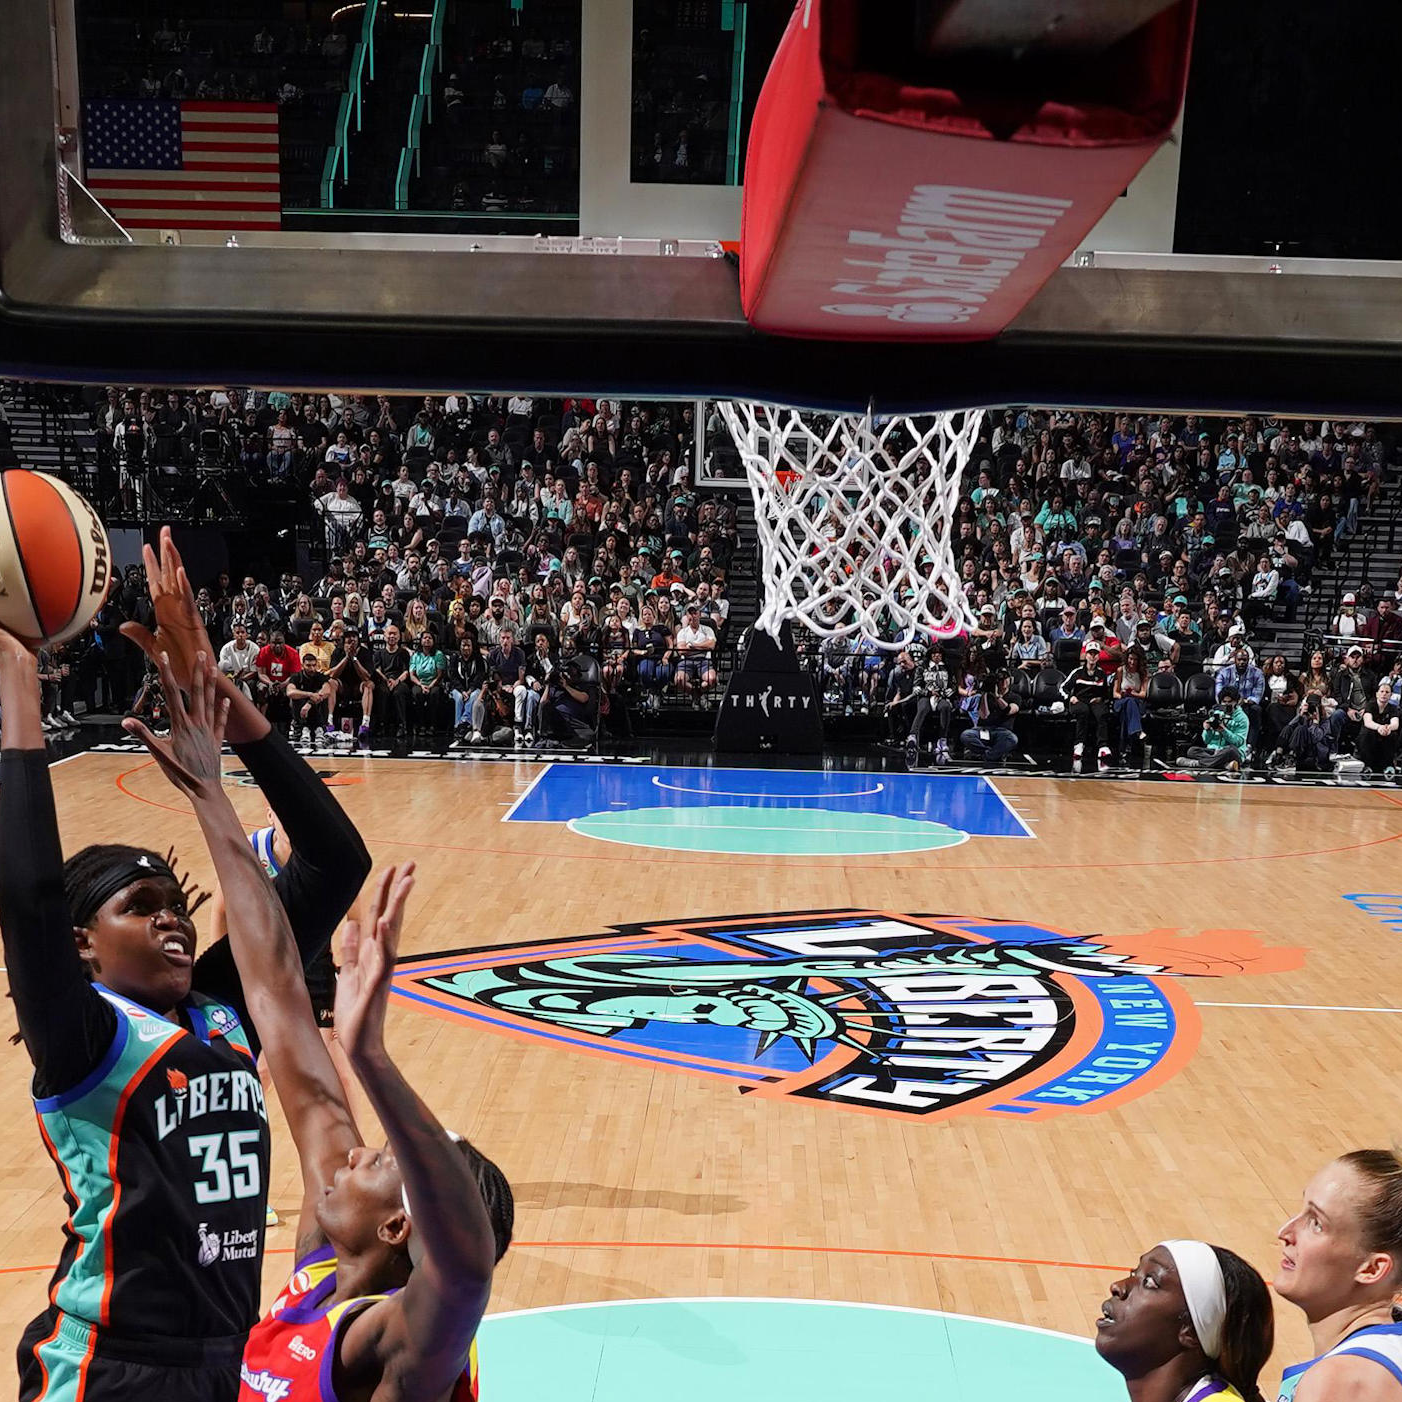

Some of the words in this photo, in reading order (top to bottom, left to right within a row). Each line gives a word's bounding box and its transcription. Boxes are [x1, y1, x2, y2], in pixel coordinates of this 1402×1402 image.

[1098, 982, 1169, 1030] NEW
[1034, 1041, 1162, 1102] YORK
[154, 1069, 268, 1142] LIBERTY
[188, 1129, 261, 1204] 35
